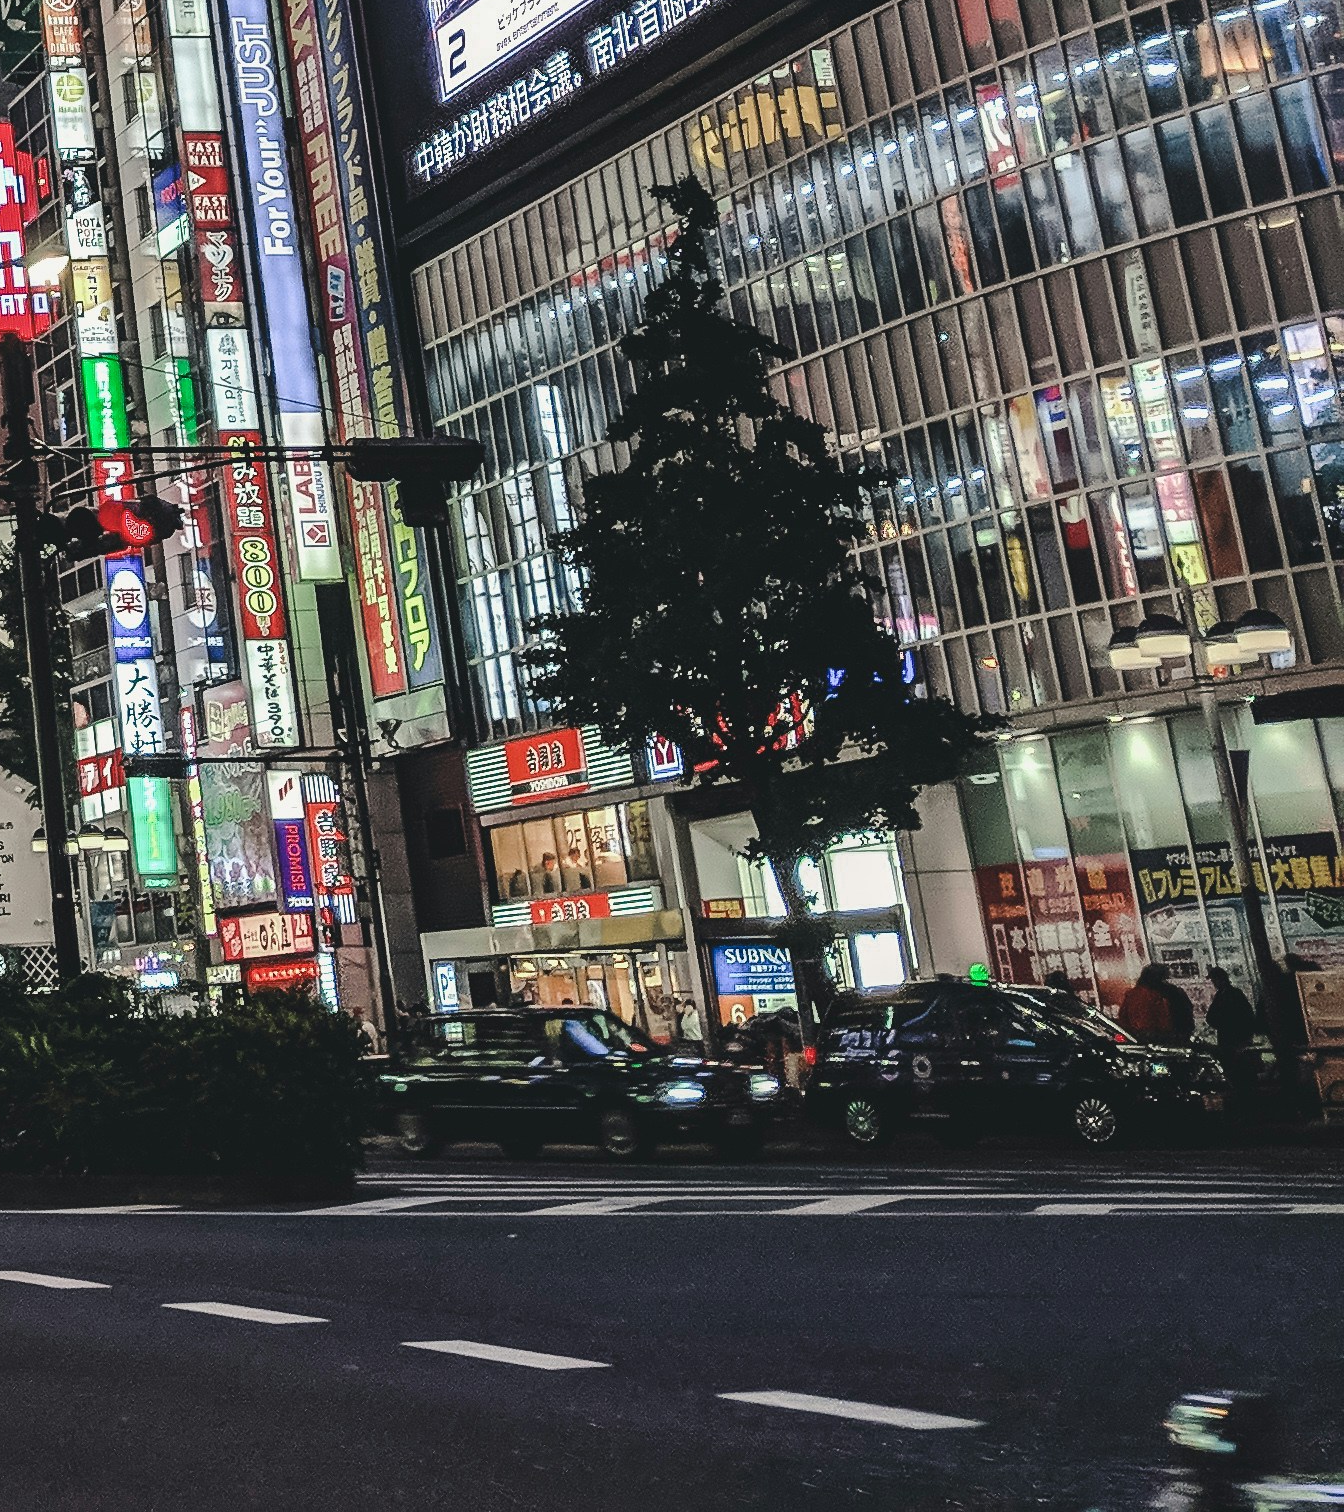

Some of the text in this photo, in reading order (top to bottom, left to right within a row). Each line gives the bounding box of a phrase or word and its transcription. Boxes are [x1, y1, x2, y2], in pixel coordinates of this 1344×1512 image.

[49, 43, 82, 54] DINING
[448, 29, 467, 78] 2
[188, 142, 221, 153] FAST
[231, 16, 295, 256] For Your JUST
[188, 154, 223, 167] NAIL
[193, 196, 228, 207] FAST
[305, 131, 344, 258] FREE
[195, 209, 230, 222] NAIL
[201, 231, 234, 303] マツエク
[218, 358, 238, 424] Rydia
[114, 587, 144, 614] 薬
[124, 668, 162, 755] 大勝軒
[526, 740, 566, 775] 吉野家
[284, 824, 306, 892] PROMISE
[724, 948, 792, 964] SUBNA
